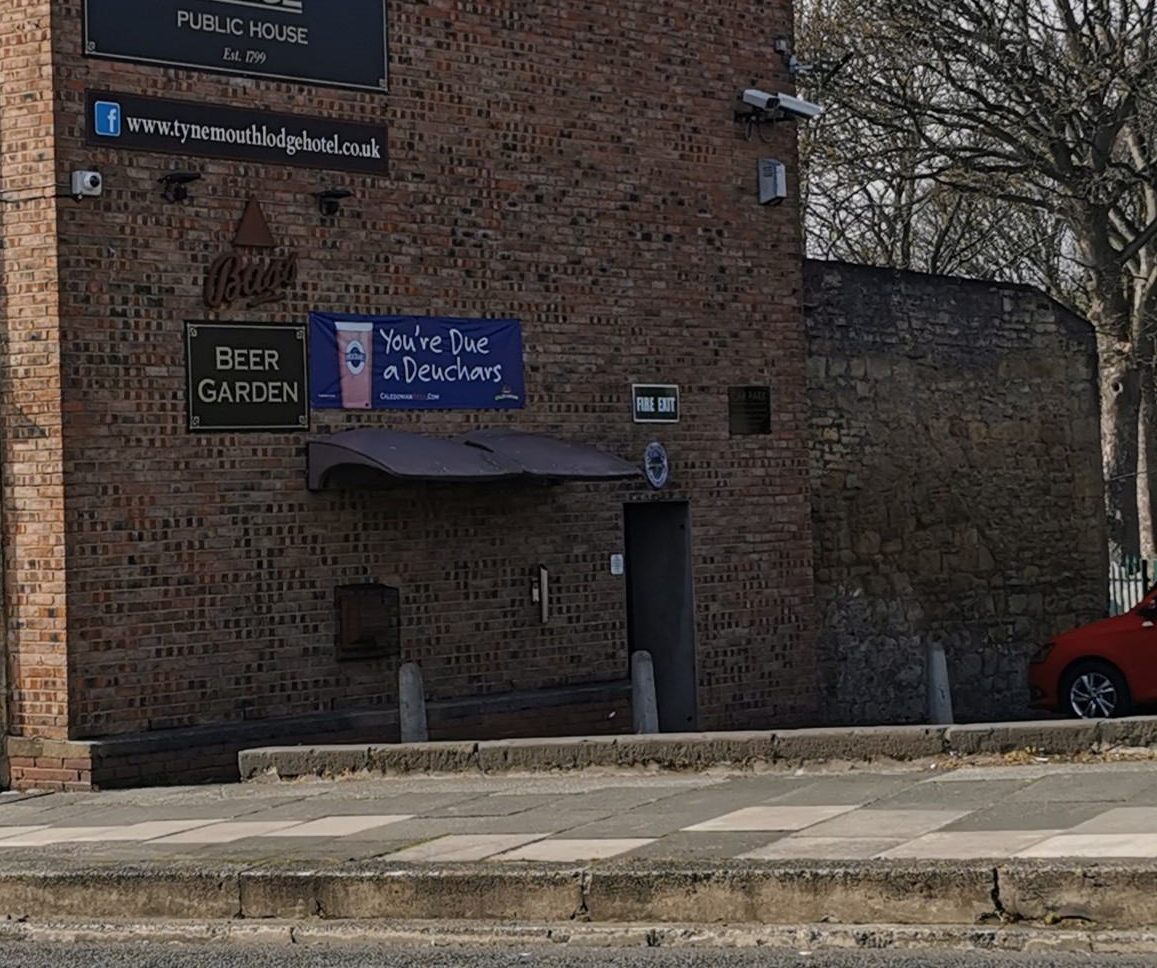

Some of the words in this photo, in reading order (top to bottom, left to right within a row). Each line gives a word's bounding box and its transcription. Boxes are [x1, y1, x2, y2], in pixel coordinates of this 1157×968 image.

[177, 10, 244, 36] PUBLIC
[249, 21, 308, 45] HOUSE
[222, 47, 242, 63] Est.
[245, 49, 267, 65] 1799
[127, 116, 381, 159] www.tynemouthlodgehotel.co.uk
[380, 324, 443, 355] You're
[449, 328, 490, 355] Due
[215, 346, 280, 371] BEER
[383, 364, 399, 381] a
[402, 356, 502, 383] Deuchars
[197, 378, 299, 403] GARDEN
[636, 396, 656, 412] FIRE
[657, 396, 676, 412] EXIT
